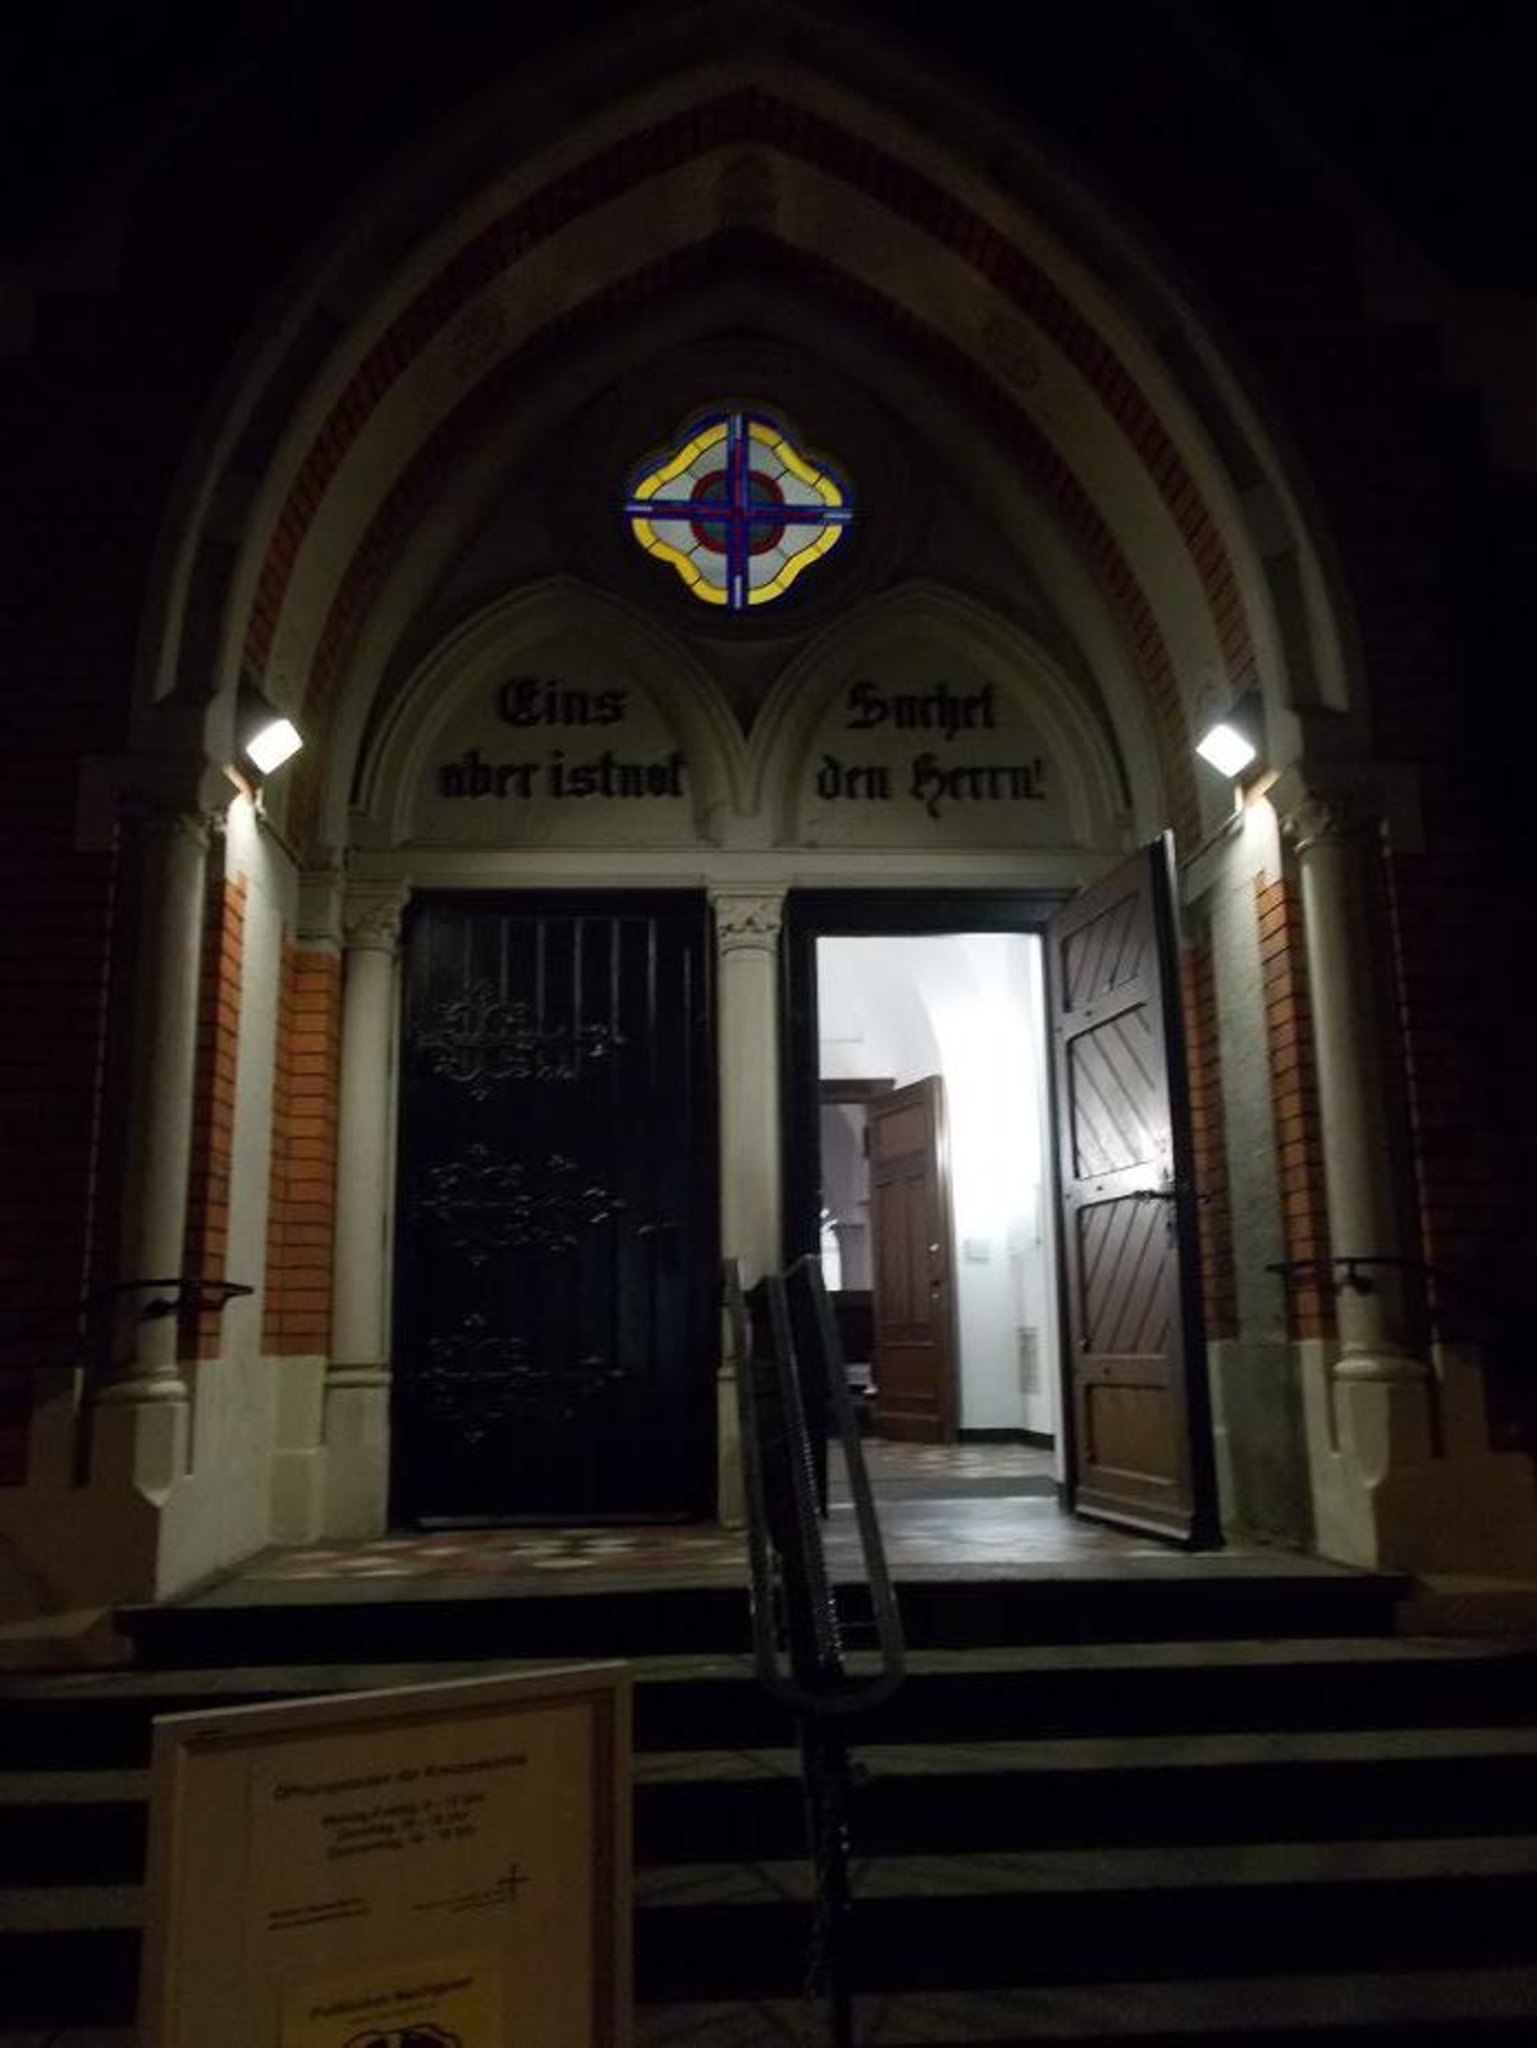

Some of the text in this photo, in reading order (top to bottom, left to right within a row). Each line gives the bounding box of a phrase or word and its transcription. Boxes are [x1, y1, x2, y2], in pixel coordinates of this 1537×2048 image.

[496, 678, 627, 728] Eins
[847, 681, 995, 741] Suchet
[438, 748, 539, 798] aber
[817, 753, 1046, 818] den Herrn!
